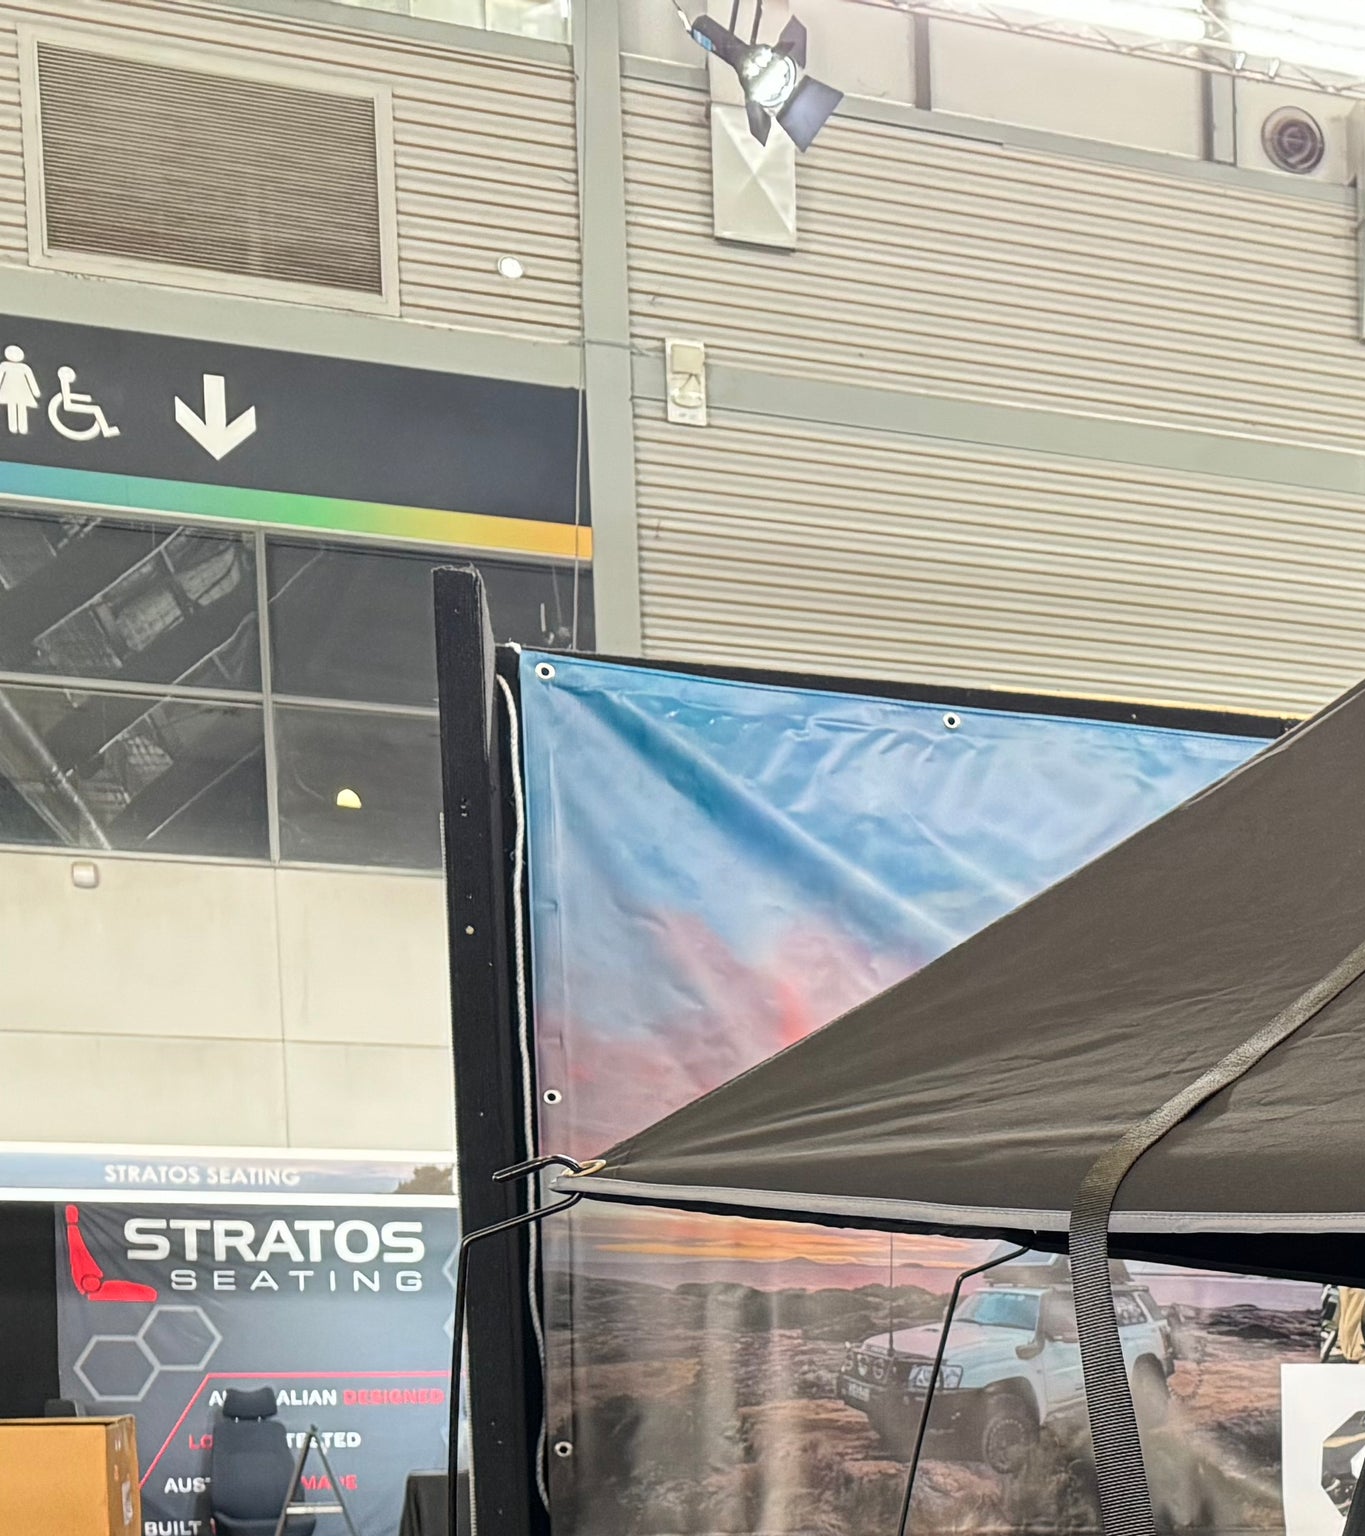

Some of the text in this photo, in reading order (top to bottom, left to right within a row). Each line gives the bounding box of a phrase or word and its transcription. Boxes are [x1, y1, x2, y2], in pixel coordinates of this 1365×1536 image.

[104, 1164, 301, 1186] STRATOS SEATING
[123, 1217, 426, 1263] STRATOS
[170, 1269, 423, 1292] SEATING
[208, 1388, 445, 1407] AALIAN DESIGNED
[300, 1475, 358, 1491] MAE
[143, 1519, 203, 1536] BUILT
